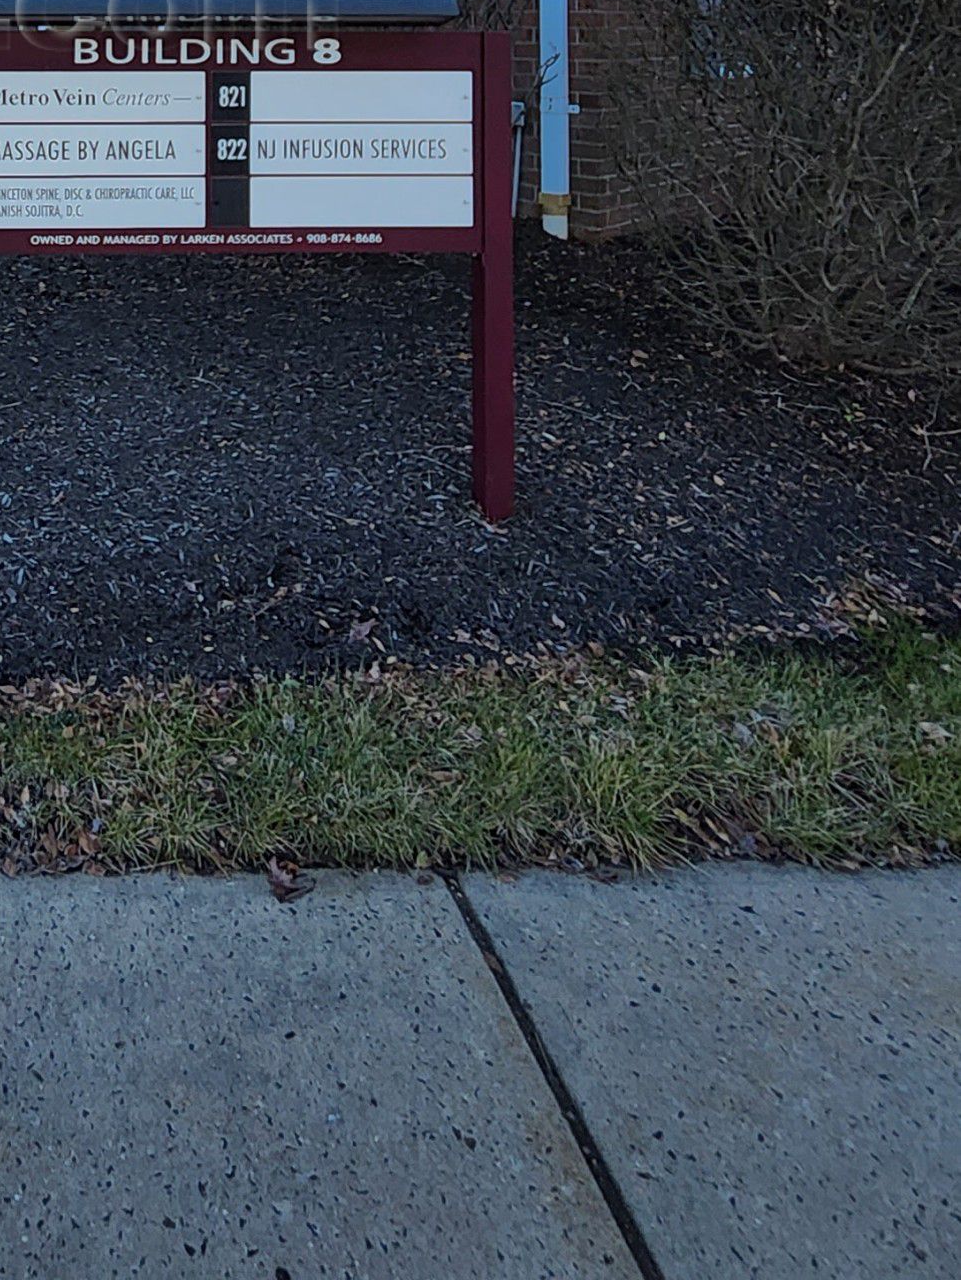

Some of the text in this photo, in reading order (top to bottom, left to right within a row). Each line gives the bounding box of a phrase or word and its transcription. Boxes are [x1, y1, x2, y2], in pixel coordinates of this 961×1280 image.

[73, 37, 342, 65] BUILDING 8
[52, 88, 97, 106] Vein
[102, 87, 171, 106] Centers
[218, 85, 247, 108] 821
[78, 140, 100, 160] BY
[105, 139, 177, 160] ANGELA
[217, 138, 248, 161] 822
[257, 138, 447, 159] NJ INFUSION SERVICES
[35, 187, 62, 201] SPINE,
[64, 187, 84, 200] DISC
[85, 189, 92, 200] &
[95, 186, 153, 200] CHIROPRACTIC
[155, 186, 178, 200] CARE,
[180, 186, 195, 200] LLC
[25, 204, 63, 219] SOJITRA,
[30, 235, 74, 245] OWNED
[76, 235, 101, 245] AND
[103, 235, 160, 245] MANAGED
[162, 234, 178, 244] BY
[180, 234, 225, 244] LARKEN
[226, 234, 294, 244] ASSOCIATES
